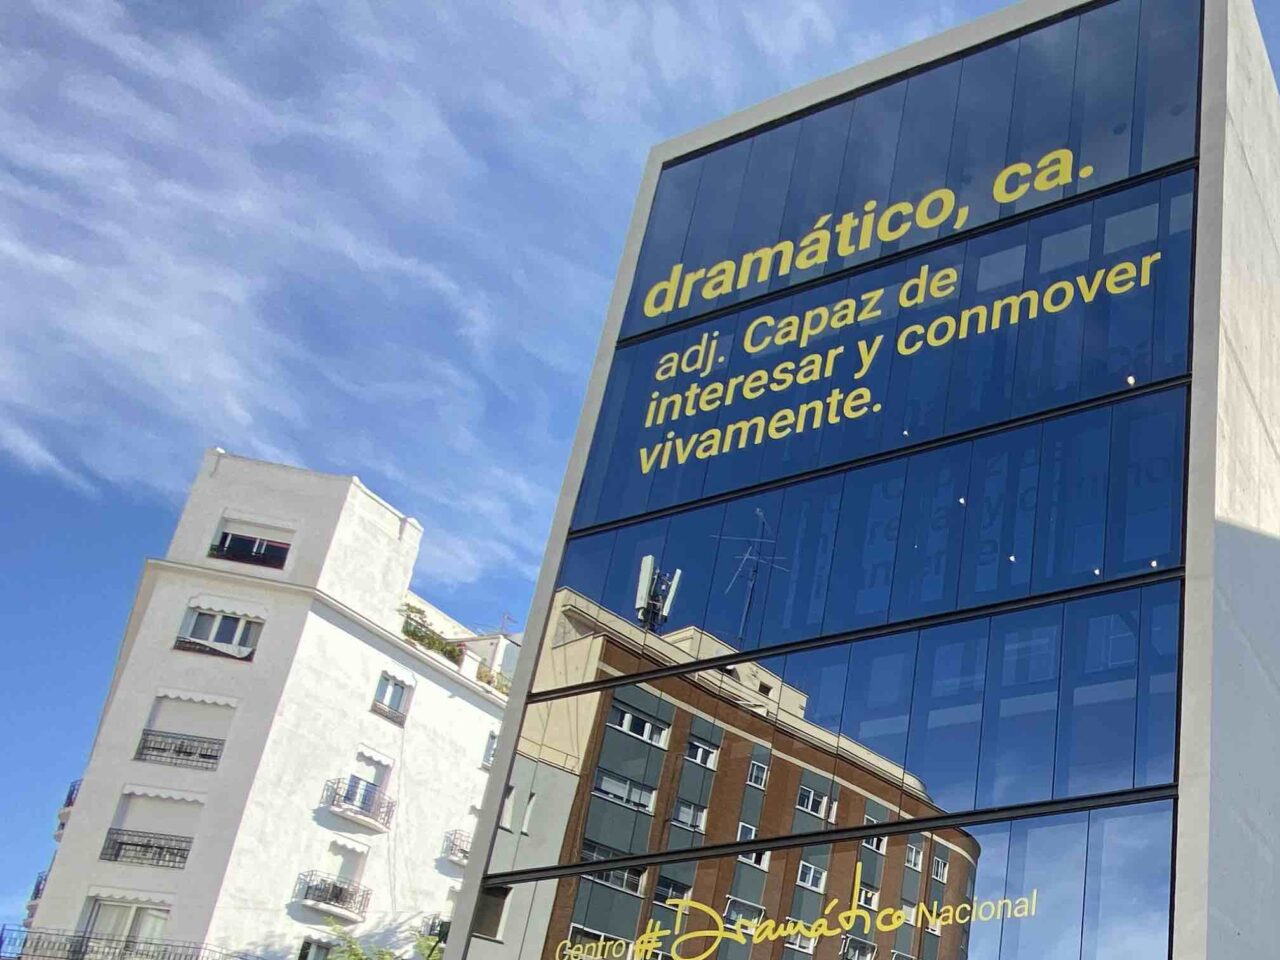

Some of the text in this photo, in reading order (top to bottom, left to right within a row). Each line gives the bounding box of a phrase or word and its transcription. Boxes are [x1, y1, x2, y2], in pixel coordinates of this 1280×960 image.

[642, 147, 1094, 318] dramático, ca.
[644, 252, 1161, 428] interesar y conmover
[655, 265, 958, 381] adj. Capaz de
[639, 387, 882, 475] vivamente.
[915, 888, 1038, 932] Nacional
